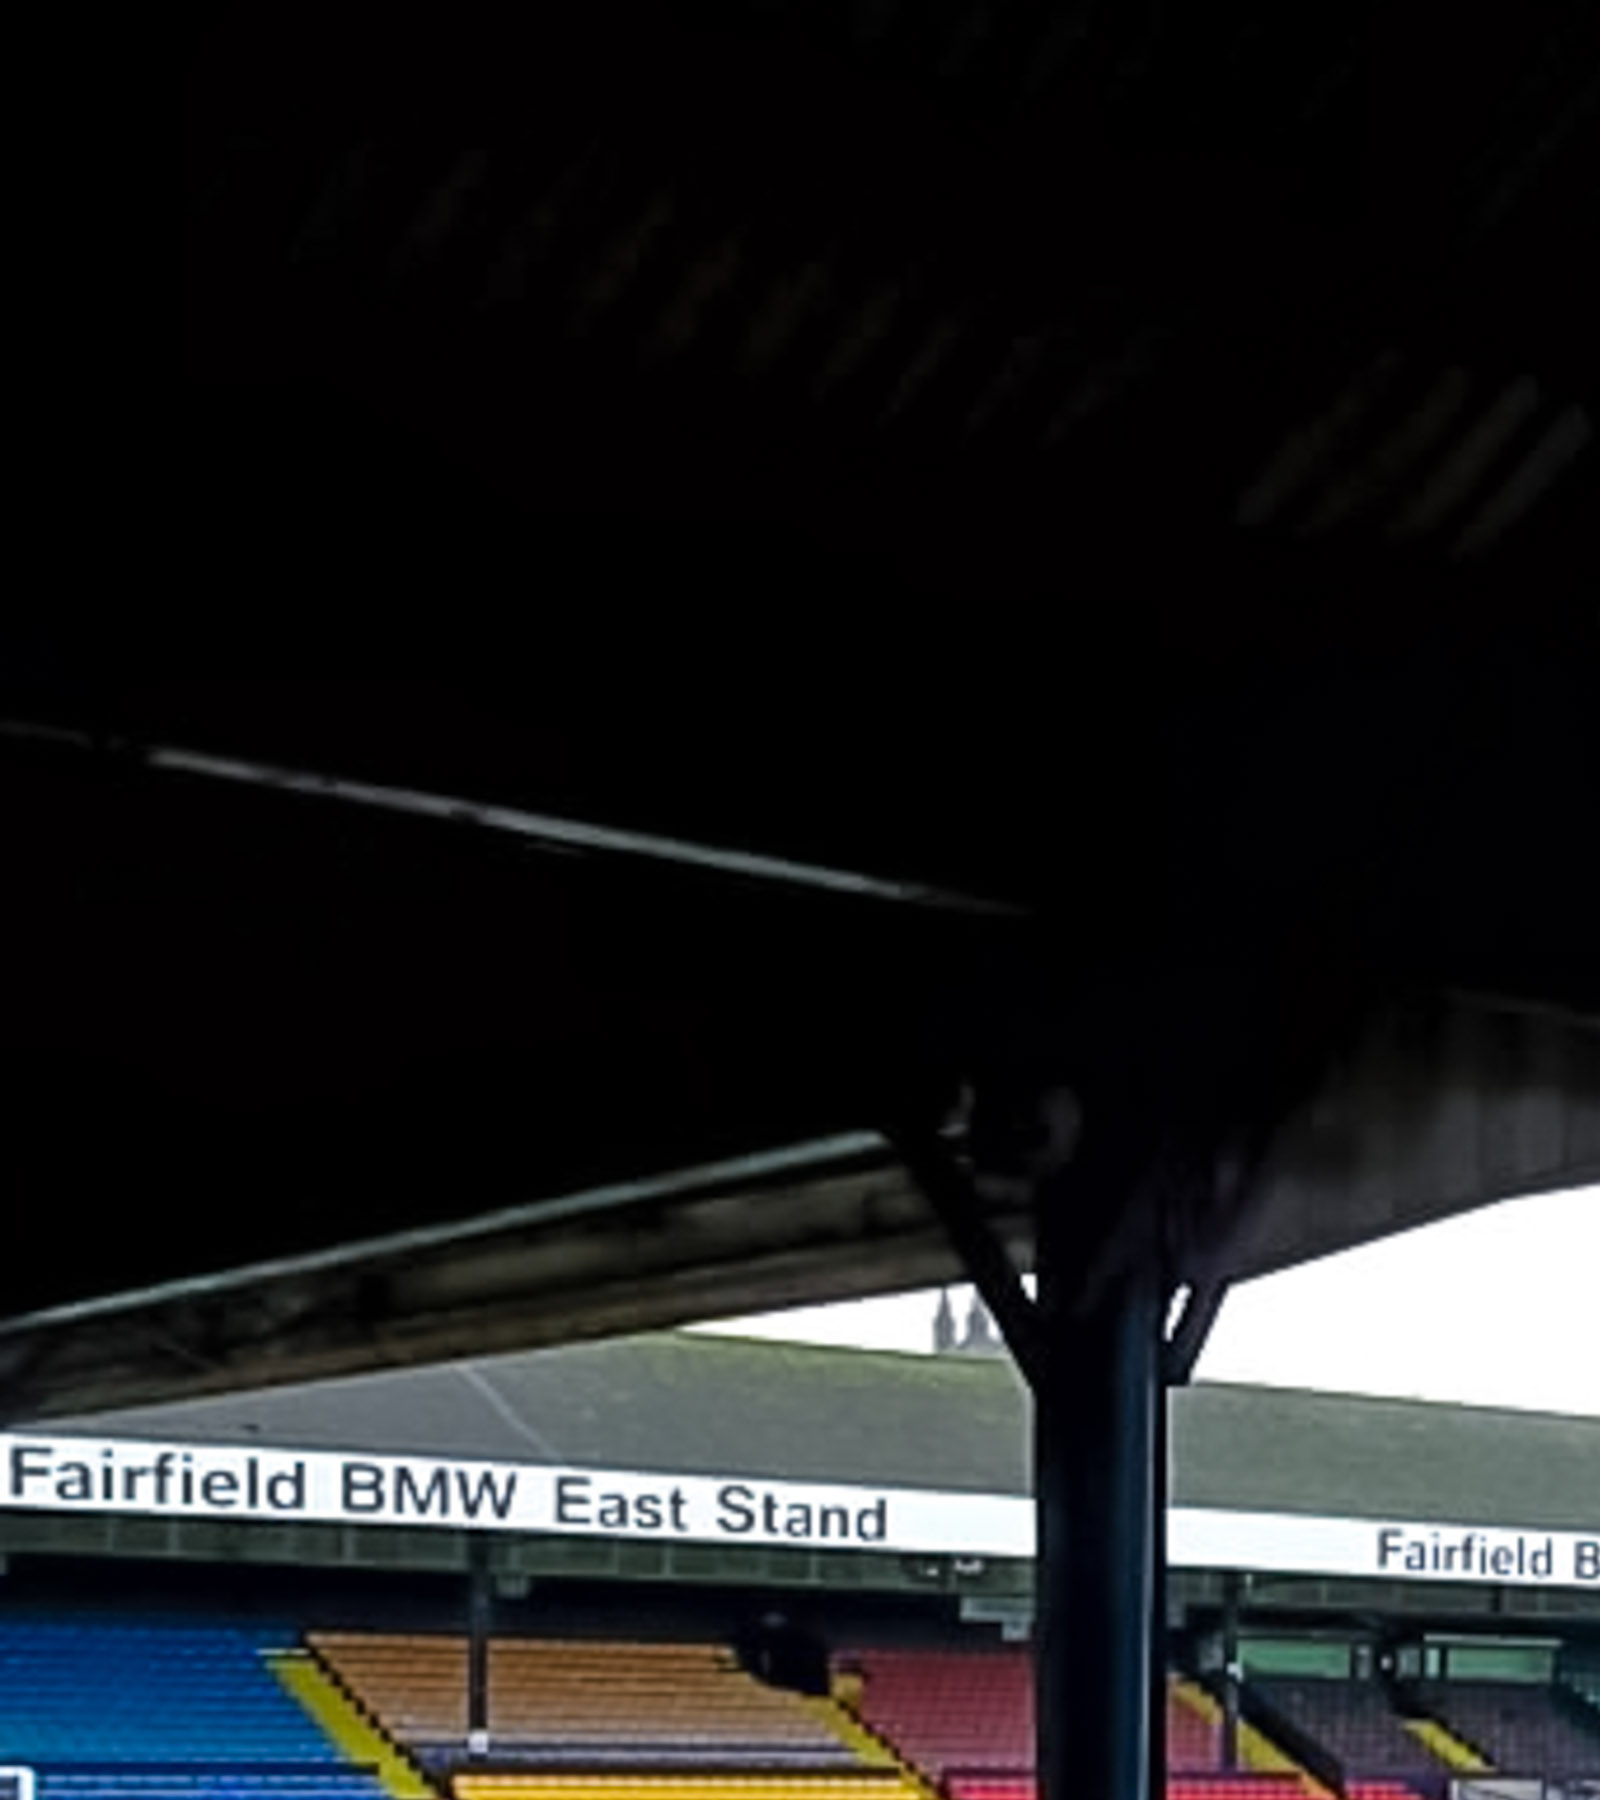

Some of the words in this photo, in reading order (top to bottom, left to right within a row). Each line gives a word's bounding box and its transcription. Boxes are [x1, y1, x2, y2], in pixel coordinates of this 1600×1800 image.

[9, 1445, 305, 1510] Fairfield
[341, 1462, 517, 1519] BMW
[555, 1475, 688, 1531] East
[716, 1485, 888, 1541] Stand
[1377, 1529, 1553, 1578] Fairfield
